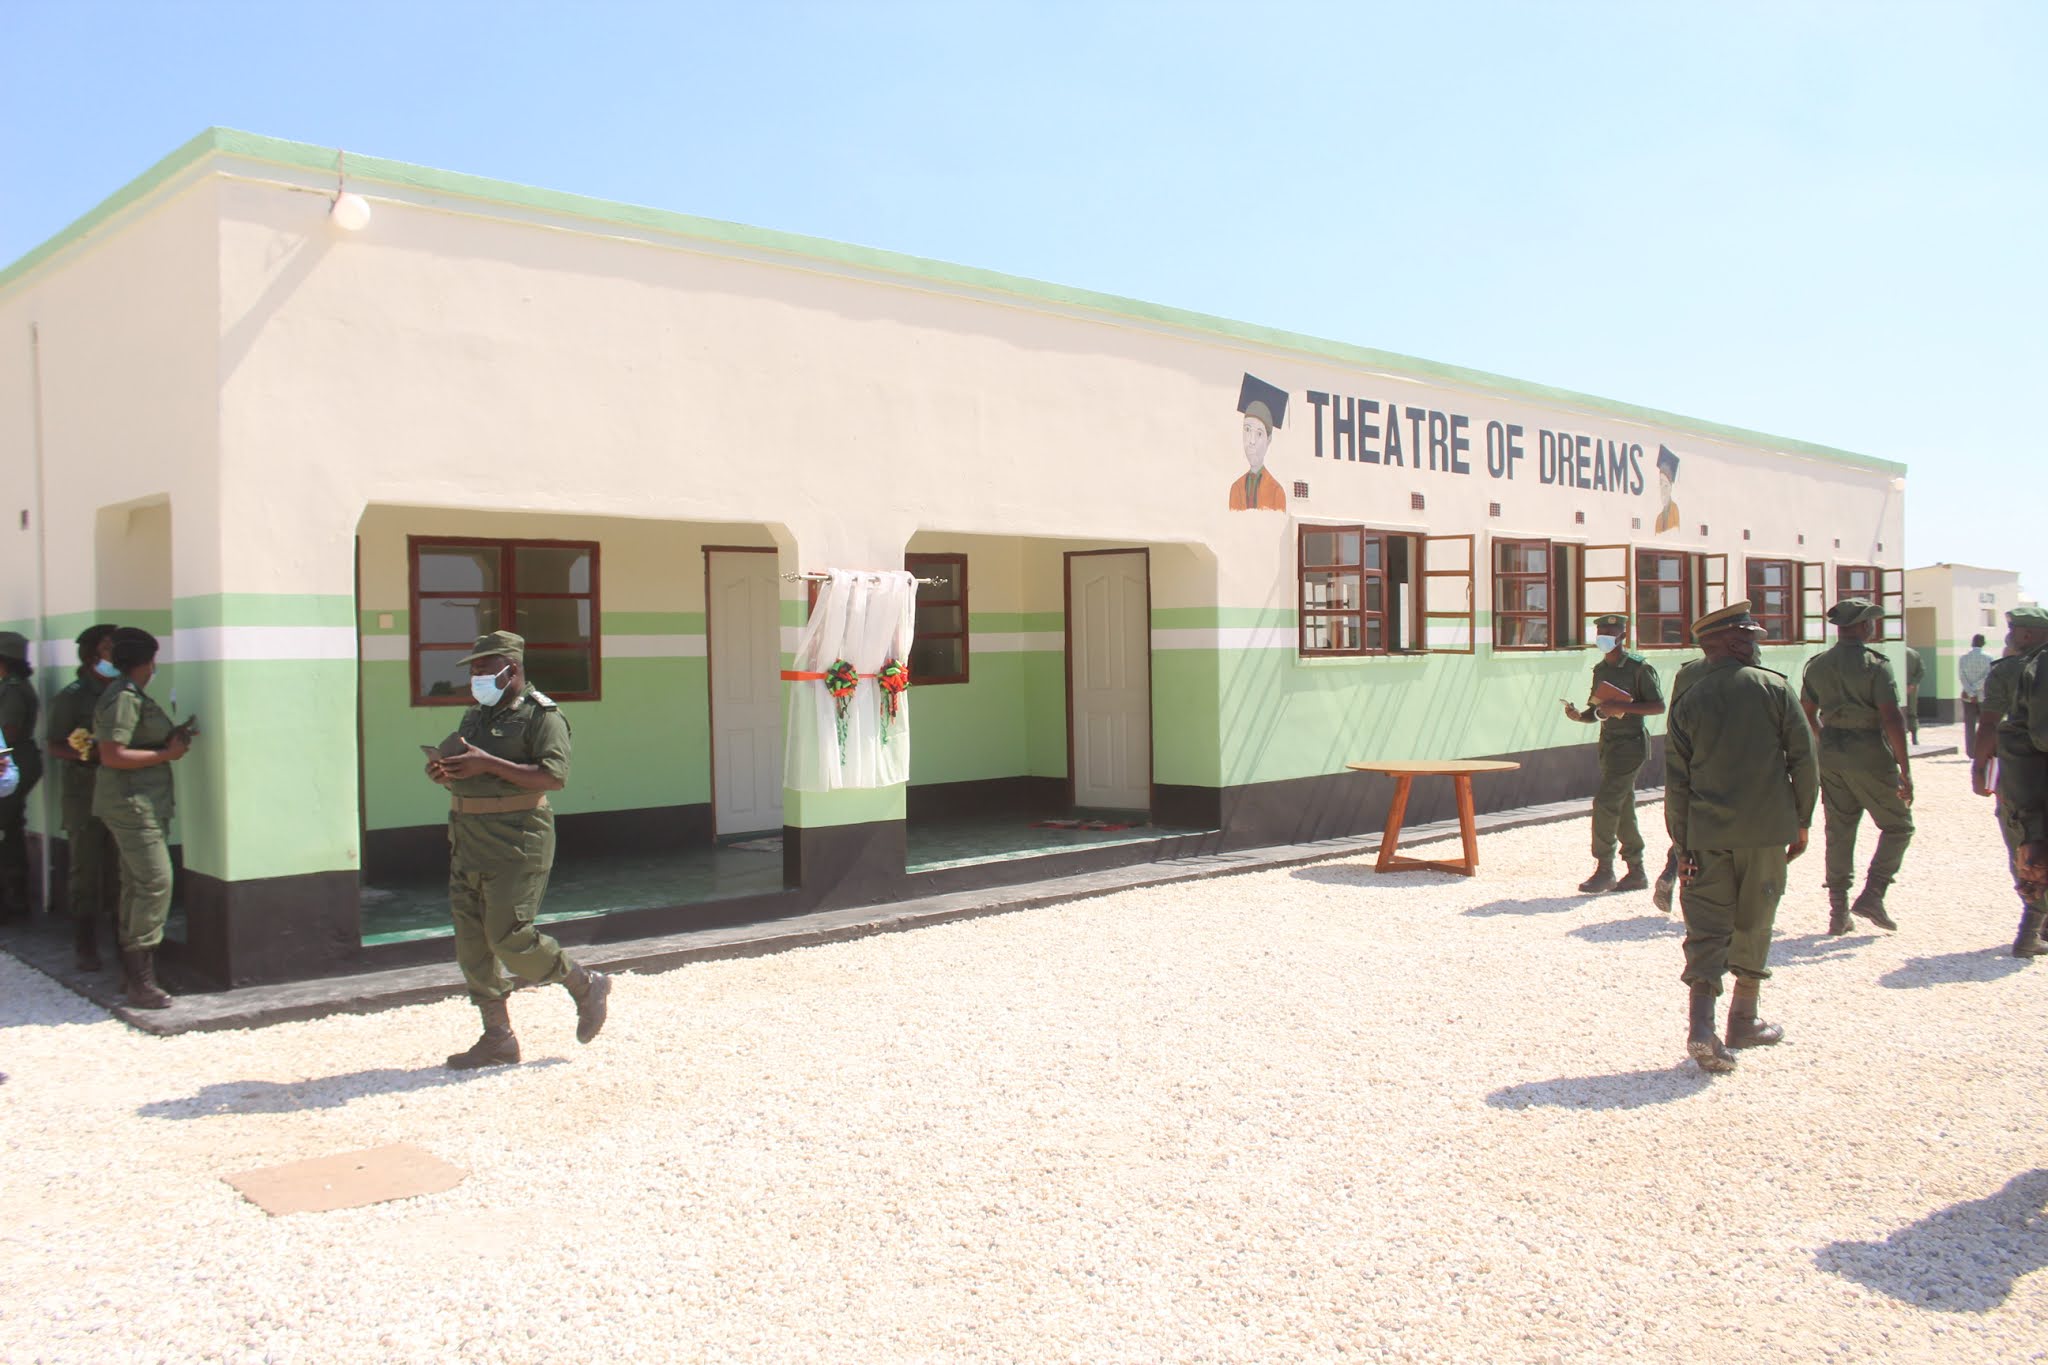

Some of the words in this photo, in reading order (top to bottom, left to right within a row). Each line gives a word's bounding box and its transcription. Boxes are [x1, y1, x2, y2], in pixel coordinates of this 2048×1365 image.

[1306, 390, 1470, 475] THEATRE
[1487, 420, 1524, 479] OF
[1539, 429, 1644, 496] DREAMS
